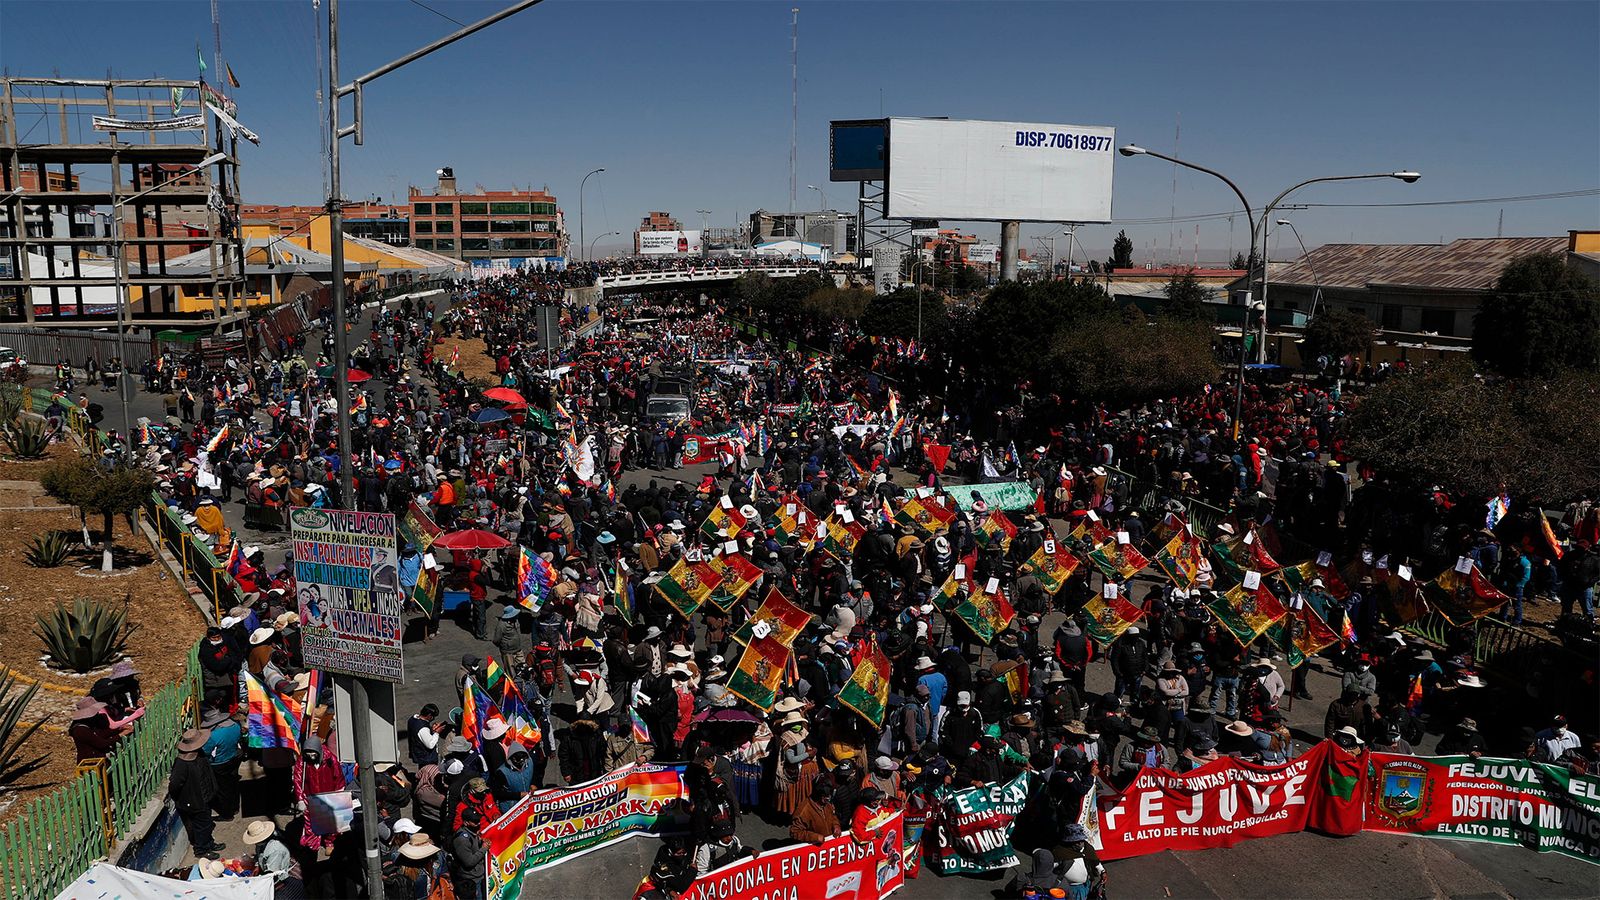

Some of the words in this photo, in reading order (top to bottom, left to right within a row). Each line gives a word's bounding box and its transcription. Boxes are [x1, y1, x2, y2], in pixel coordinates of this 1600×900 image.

[293, 529, 331, 542] PREPÁRATE
[331, 533, 350, 544] PARA
[351, 535, 386, 548] INGRESAR
[387, 540, 395, 548] A:
[1047, 543, 1053, 552] 5
[294, 541, 317, 562] INST.
[318, 544, 371, 567] POLICIALES
[296, 561, 319, 583] INST.
[320, 565, 369, 588] MILITARES
[328, 586, 348, 610] UMSA
[352, 589, 371, 612] UPEA
[376, 592, 398, 616] INCOS
[1168, 778, 1183, 789] DE
[1186, 773, 1225, 791] JUNTAS
[1448, 763, 1544, 784] FEJUVE
[534, 784, 618, 813] ORGANIZACIÓN
[1446, 782, 1503, 790] FEDERACIÓN
[1506, 785, 1519, 793] DE
[1105, 775, 1307, 830] FEJUVE
[1452, 794, 1533, 825] DISTRITO
[957, 808, 994, 826] JUNTAS
[1124, 832, 1134, 842] EL
[1137, 829, 1161, 840] ALTO
[1164, 828, 1177, 836] DE
[1180, 827, 1199, 836] PIE
[1202, 825, 1233, 836] NUNC
[1234, 820, 1246, 830] DE
[1438, 824, 1452, 833] EL
[1456, 824, 1488, 836] ALTO
[1492, 827, 1509, 838] DE
[1513, 830, 1536, 844] PIE
[530, 847, 548, 856] FUND.
[563, 831, 596, 846] DICIEMBRE
[782, 856, 800, 878] EN
[807, 841, 875, 872] DEFENSA
